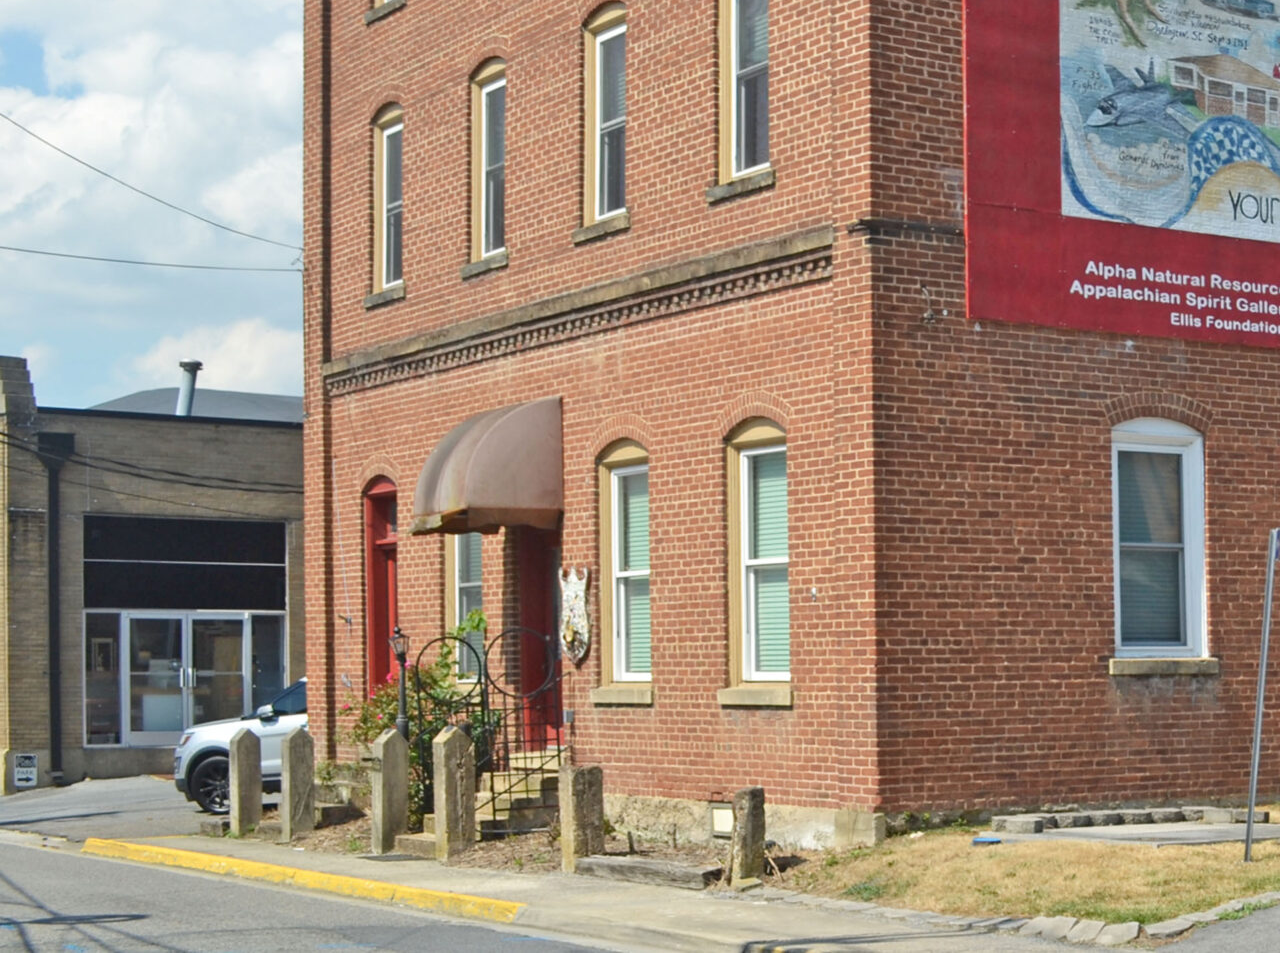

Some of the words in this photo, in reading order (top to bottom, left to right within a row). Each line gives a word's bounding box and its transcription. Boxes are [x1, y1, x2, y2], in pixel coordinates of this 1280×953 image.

[1084, 260, 1137, 280] Alpha
[1141, 266, 1206, 287] Natural
[1069, 279, 1181, 305] Appalachian
[1185, 291, 1233, 311] Spirit
[1170, 312, 1202, 328] Ellis
